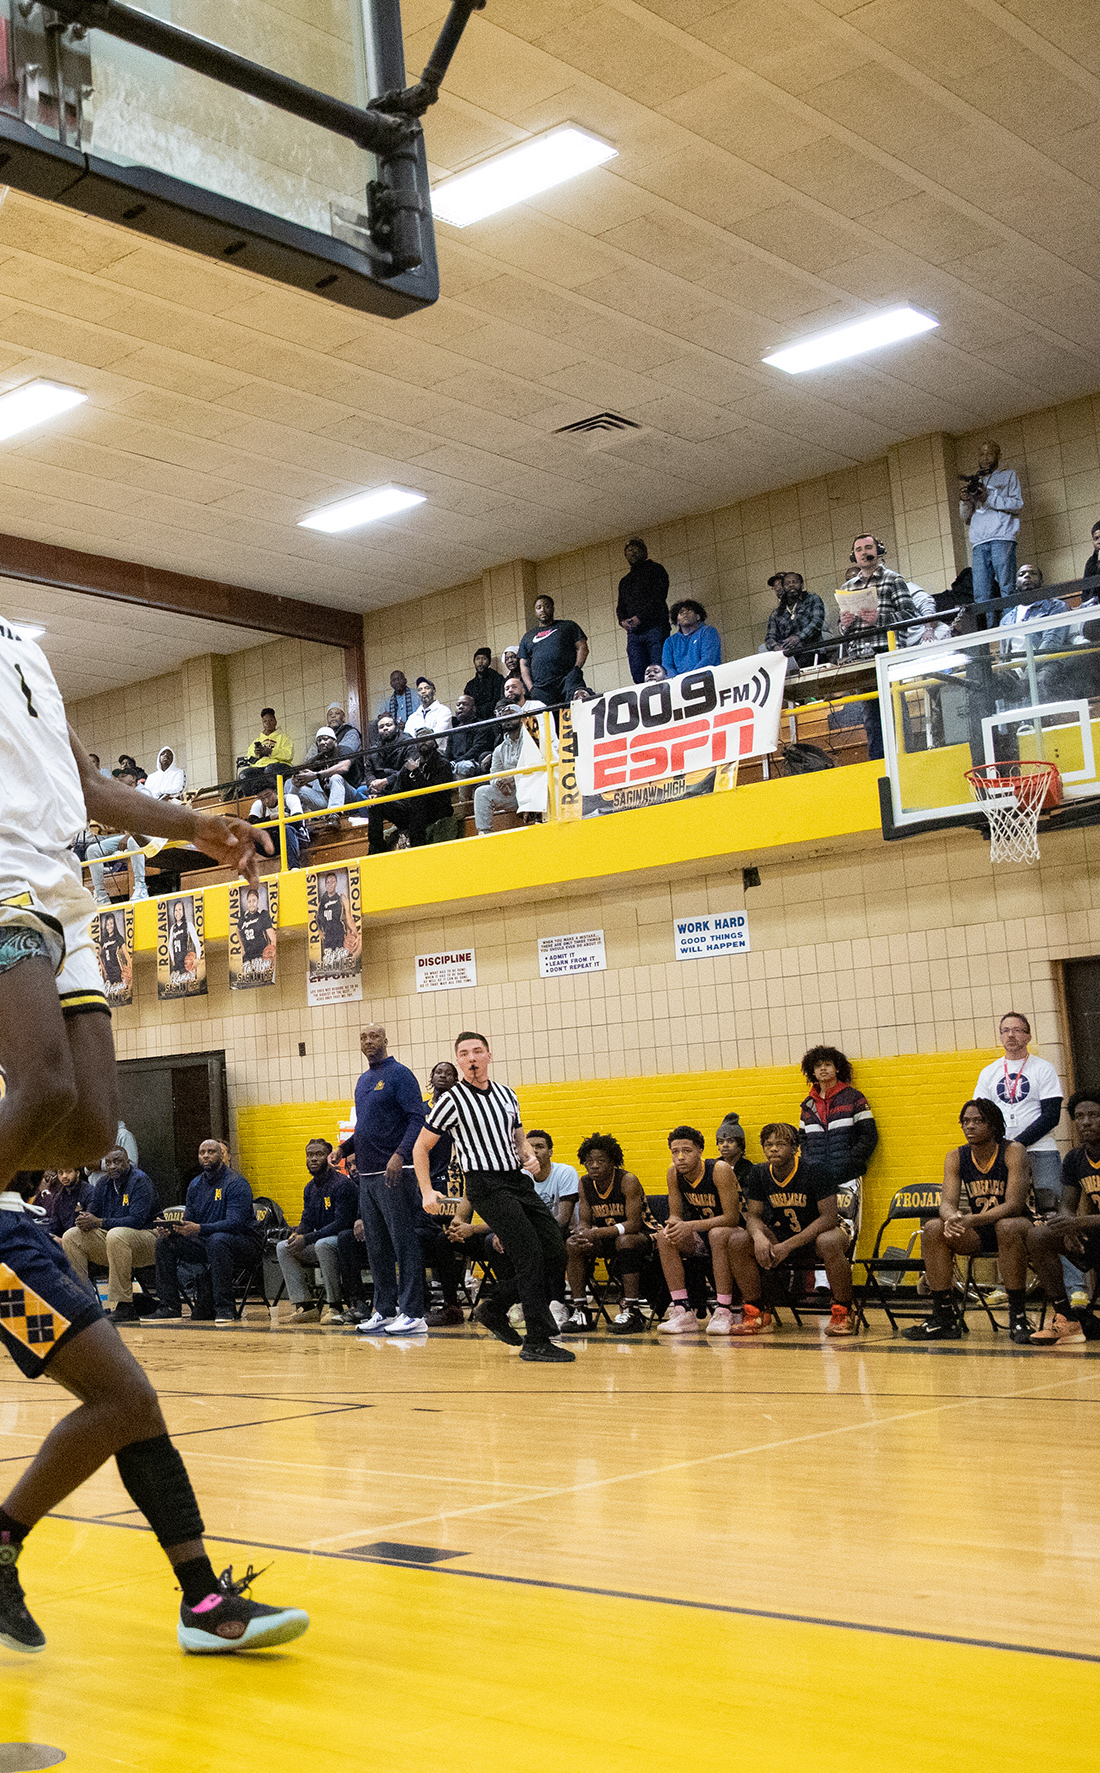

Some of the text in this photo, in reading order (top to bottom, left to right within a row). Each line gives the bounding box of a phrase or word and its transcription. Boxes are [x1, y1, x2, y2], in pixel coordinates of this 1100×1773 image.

[591, 669, 750, 740] 100.9 FM
[593, 707, 754, 790] ESPN
[613, 780, 686, 808] SAGINAW HIGH
[677, 916, 745, 934] WORK HARD
[681, 931, 743, 945] GOOD THINGS
[707, 940, 745, 951] HAPPEN
[418, 953, 471, 967] DISCIPLINE
[570, 962, 592, 970] REPEAT
